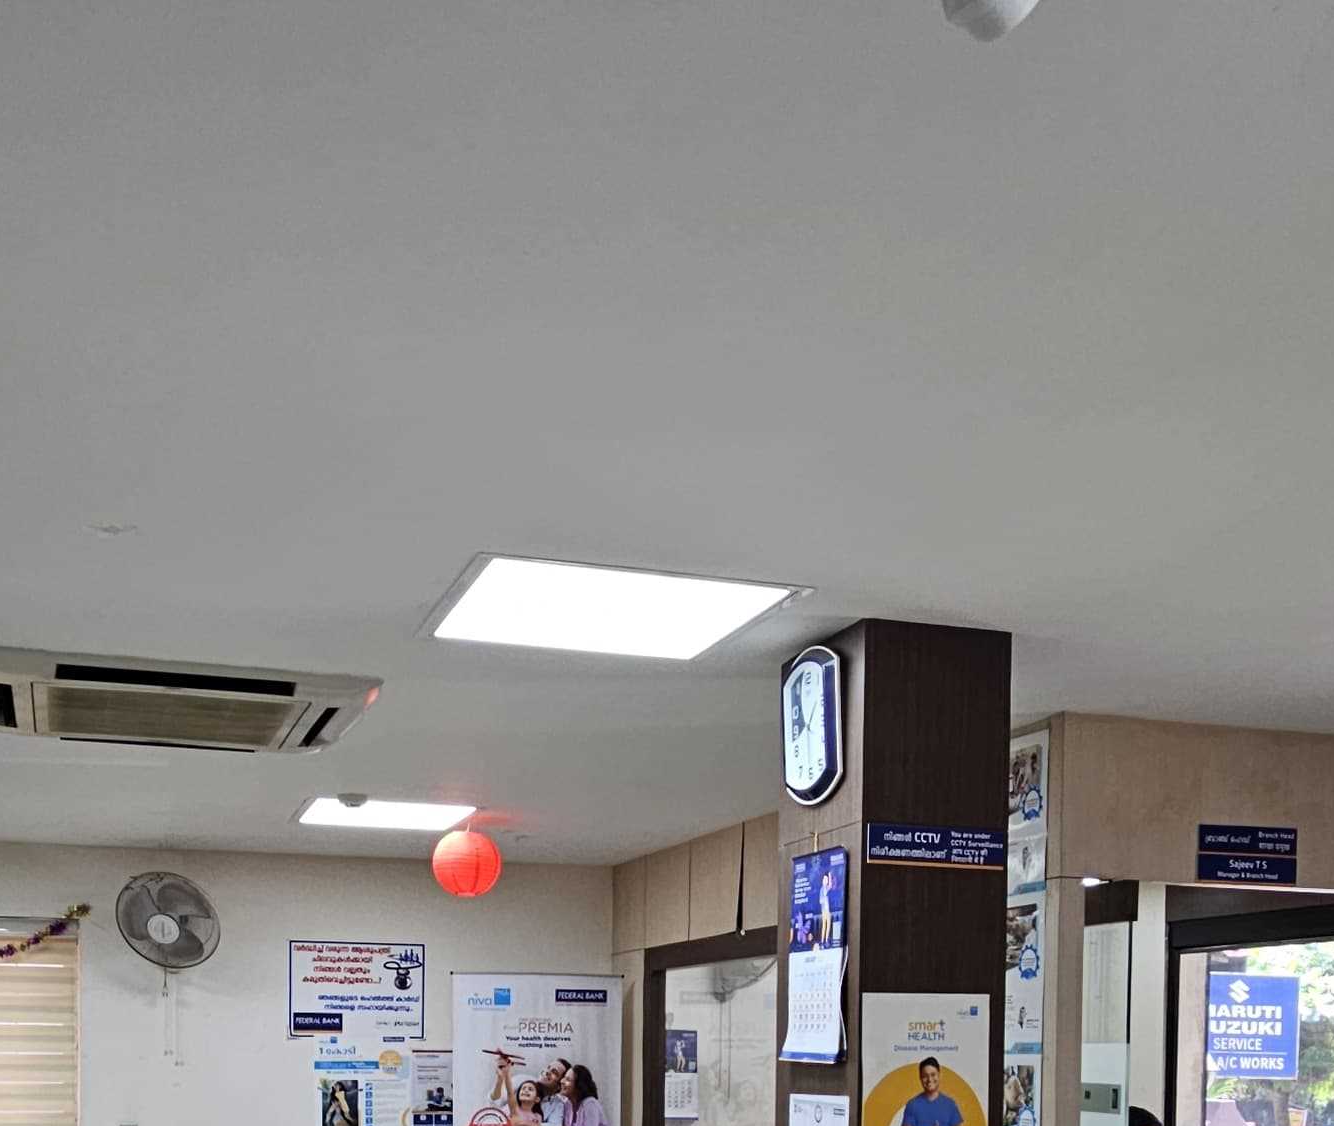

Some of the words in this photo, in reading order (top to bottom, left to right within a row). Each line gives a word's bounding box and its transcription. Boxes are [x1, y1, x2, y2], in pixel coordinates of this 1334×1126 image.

[914, 832, 941, 843] CCTV
[1258, 831, 1278, 839] Branch
[1229, 859, 1255, 870] Sajeev
[1217, 871, 1240, 879] Manager
[467, 993, 492, 1006] niva
[557, 992, 584, 1000] FEDERAL
[585, 992, 605, 1000] BANK
[295, 1017, 321, 1025] FEDERAL
[322, 1017, 340, 1025] BANK
[908, 1019, 946, 1032] smart
[519, 1022, 574, 1034] PREMIA
[1210, 1020, 1282, 1036] UZUKI
[907, 1032, 945, 1041] HEALTH
[893, 1044, 918, 1052] Disease
[920, 1044, 959, 1052] Management
[1213, 1037, 1263, 1051] SERVICE
[1218, 1056, 1237, 1070] A/C
[1240, 1057, 1284, 1070] WORKS
